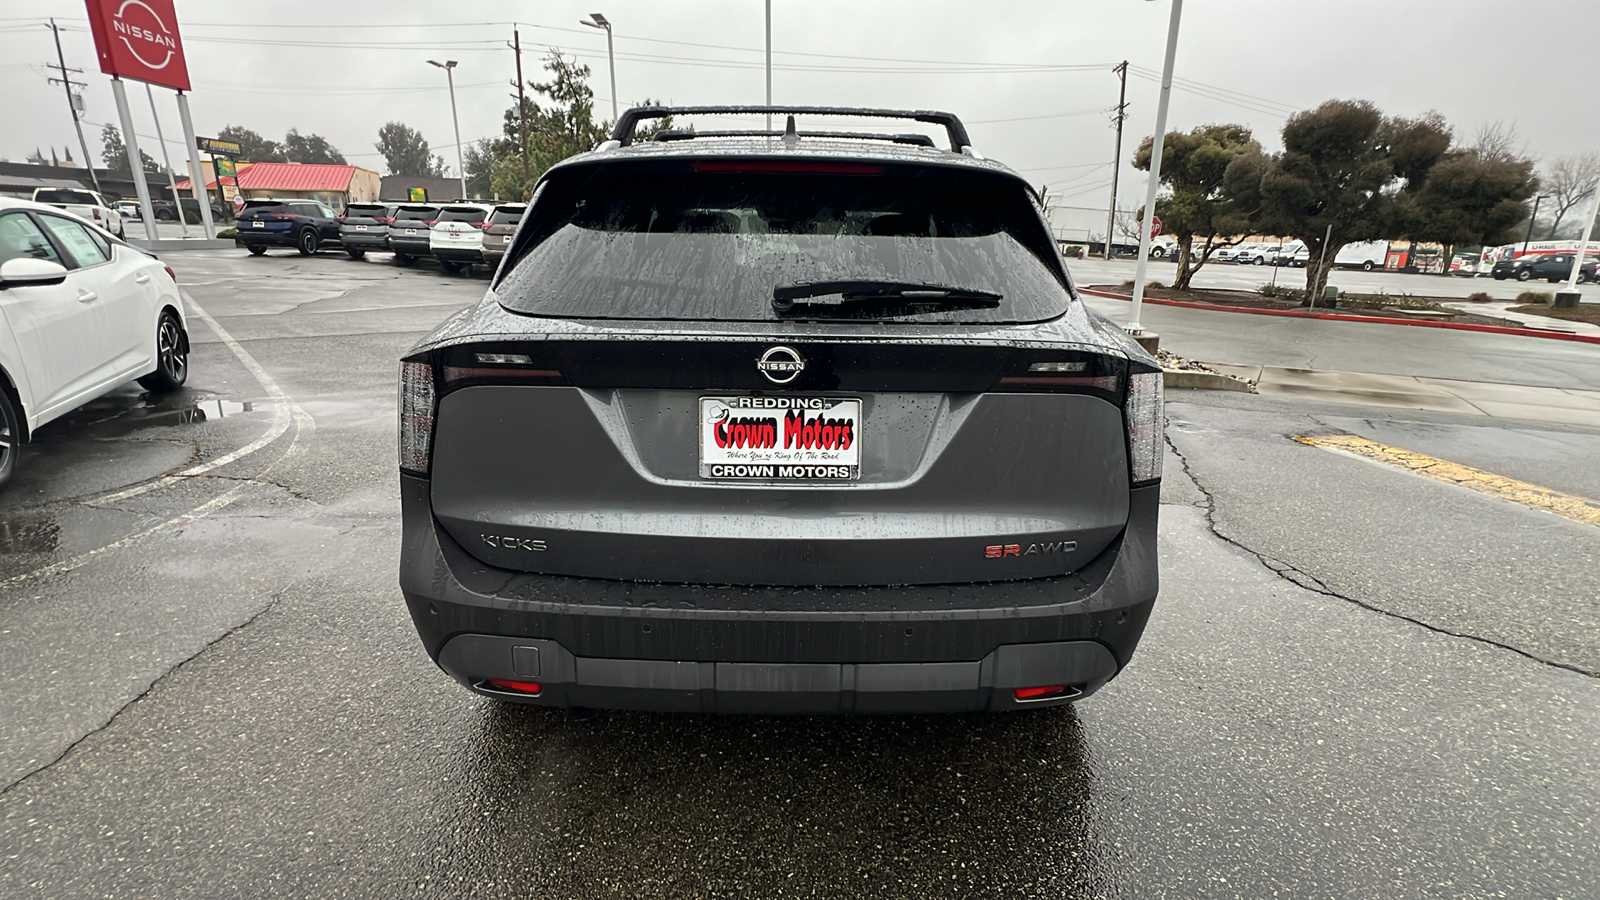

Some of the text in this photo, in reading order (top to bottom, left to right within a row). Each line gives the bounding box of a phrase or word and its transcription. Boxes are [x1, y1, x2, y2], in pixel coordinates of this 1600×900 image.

[113, 20, 176, 49] NISSAN
[757, 361, 805, 371] NISSAN
[739, 398, 823, 409] REDDING
[714, 409, 854, 450] Crown Motors
[727, 451, 839, 461] Where You're King Of The Road
[712, 465, 849, 478] CROWN MOTORS
[481, 534, 547, 552] KICKS
[984, 541, 1078, 558] SR AWD
